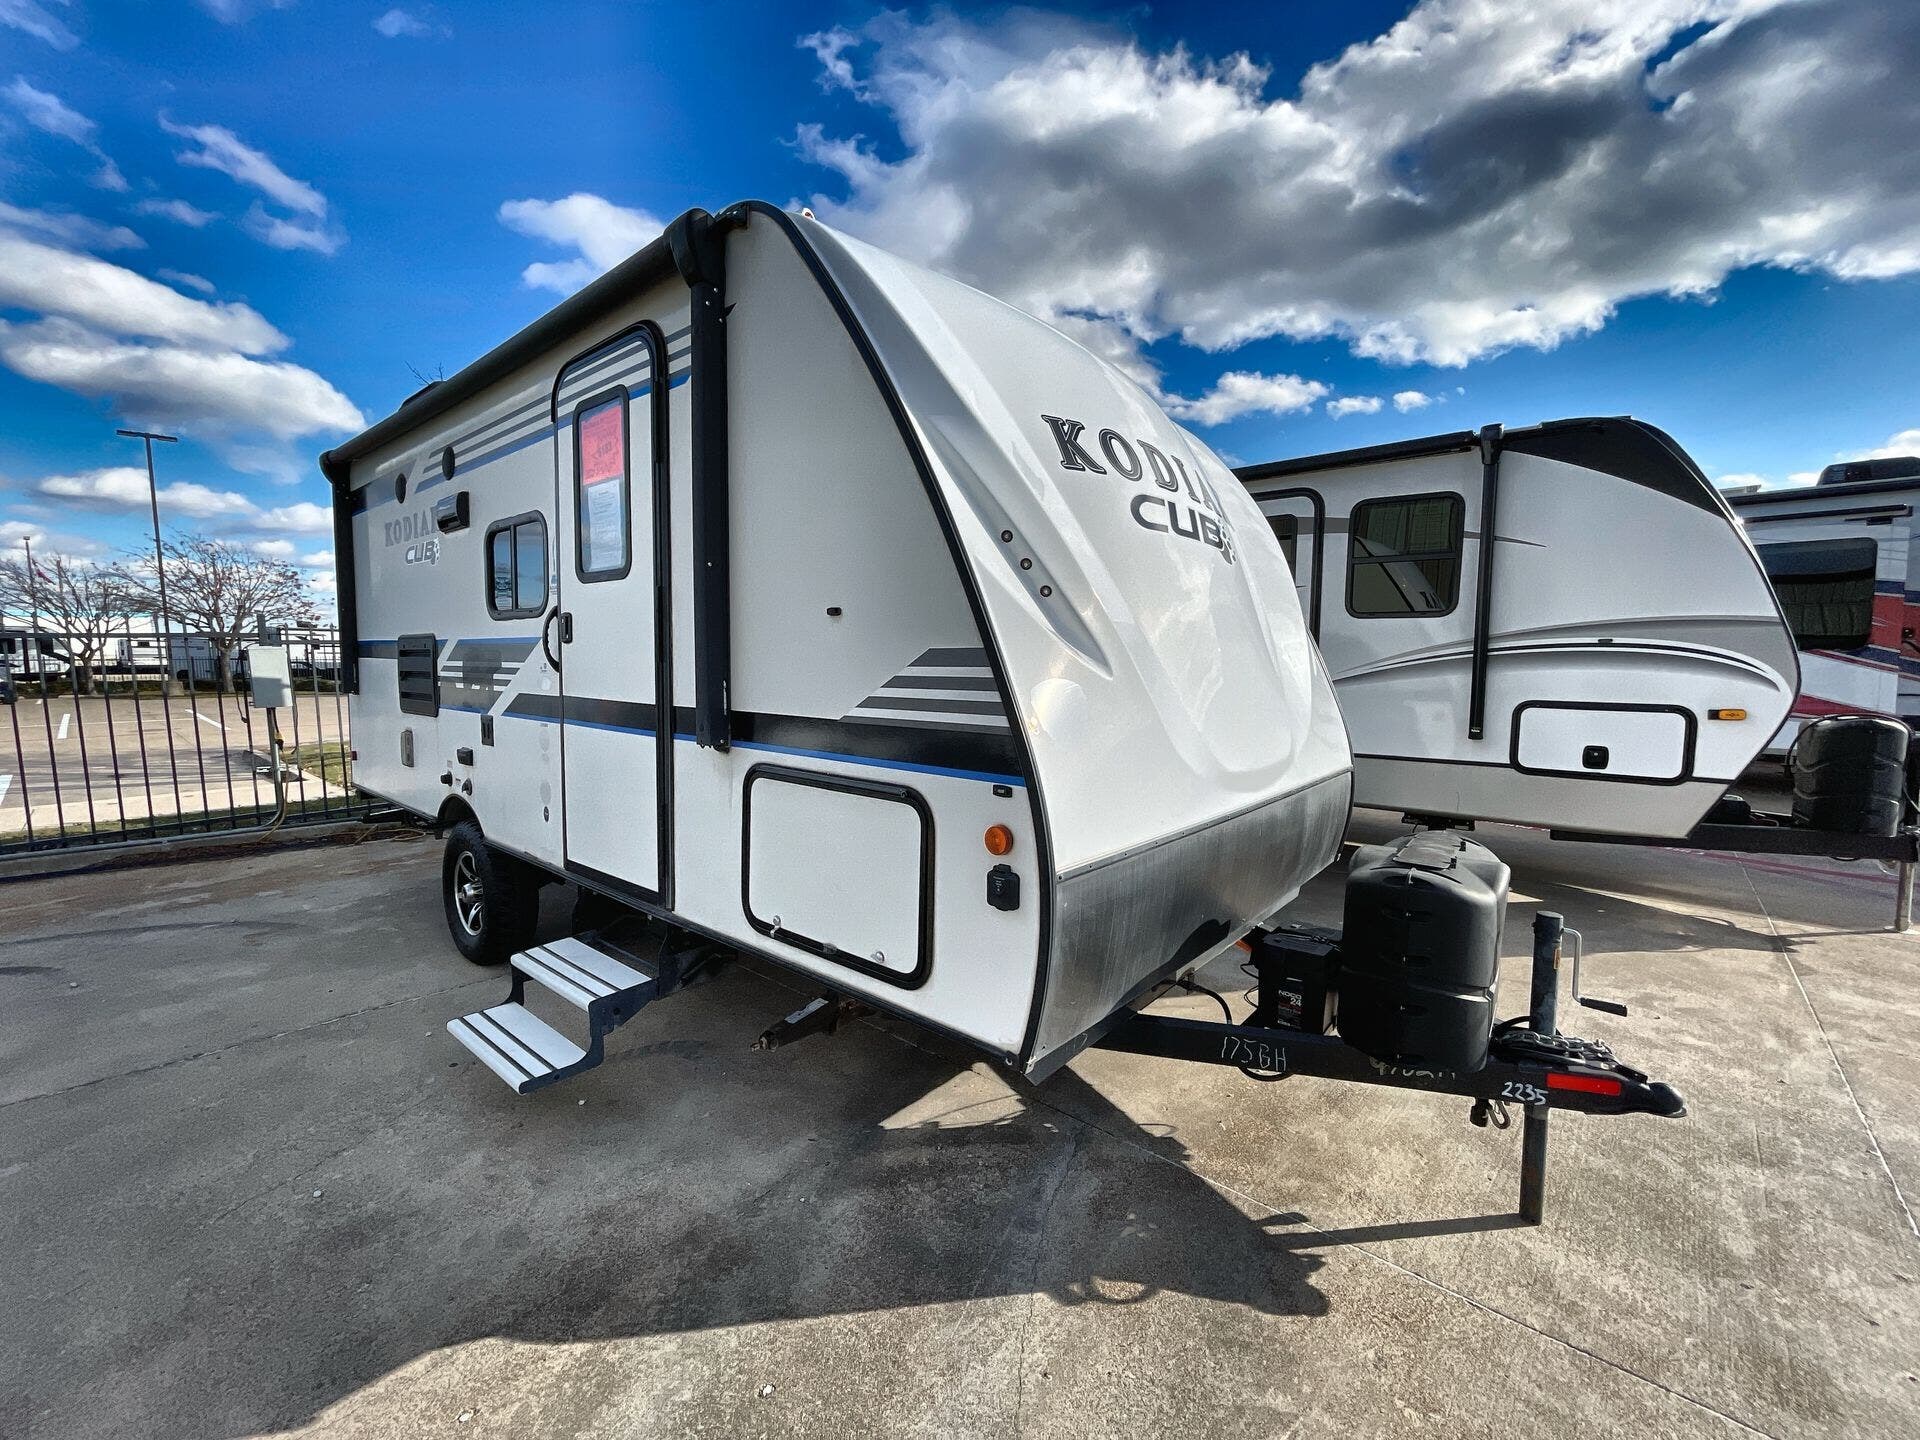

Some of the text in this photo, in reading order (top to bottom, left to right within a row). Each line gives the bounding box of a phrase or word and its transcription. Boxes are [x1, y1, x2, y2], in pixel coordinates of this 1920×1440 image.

[1040, 414, 1222, 518] KODIA
[1130, 494, 1224, 550] CUB
[405, 540, 437, 565] CUB
[1221, 1036, 1288, 1072] 175BH
[1501, 1081, 1549, 1106] 2235
